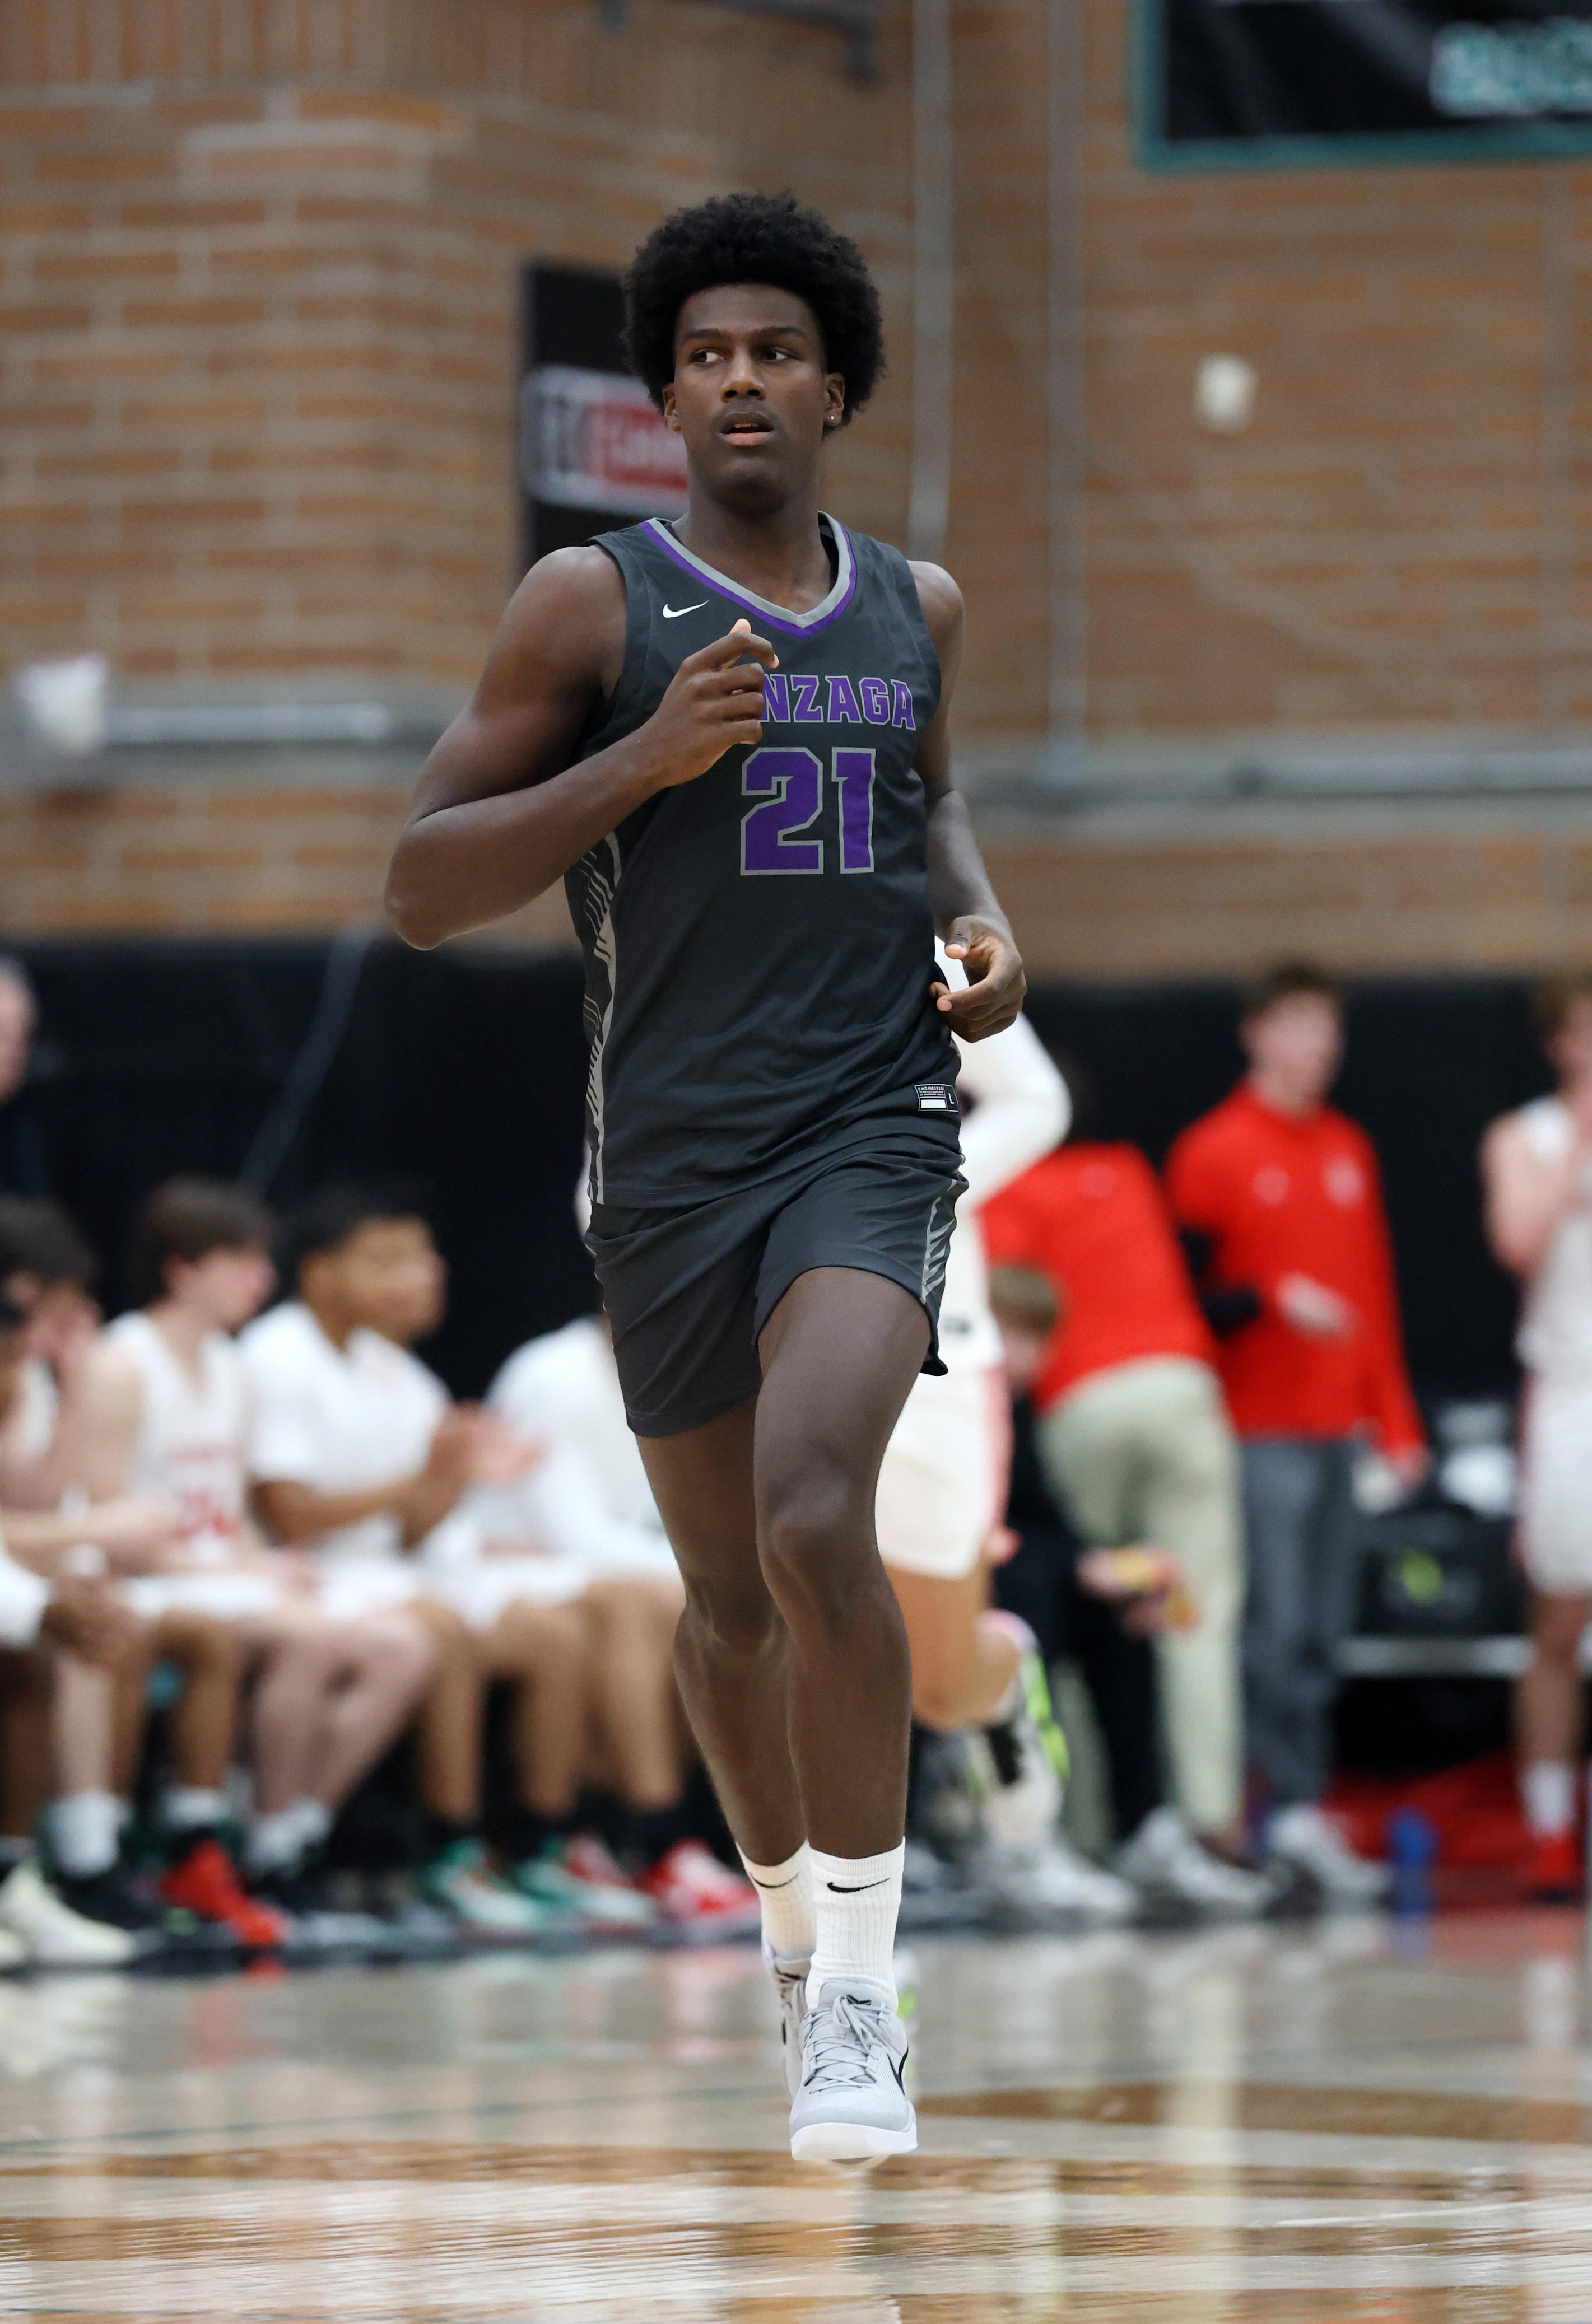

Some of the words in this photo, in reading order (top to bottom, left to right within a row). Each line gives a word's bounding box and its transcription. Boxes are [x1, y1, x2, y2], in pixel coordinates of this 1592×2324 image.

[760, 674, 916, 731] NZAGA
[740, 746, 876, 875] 21
[948, 1093, 955, 1104] L
